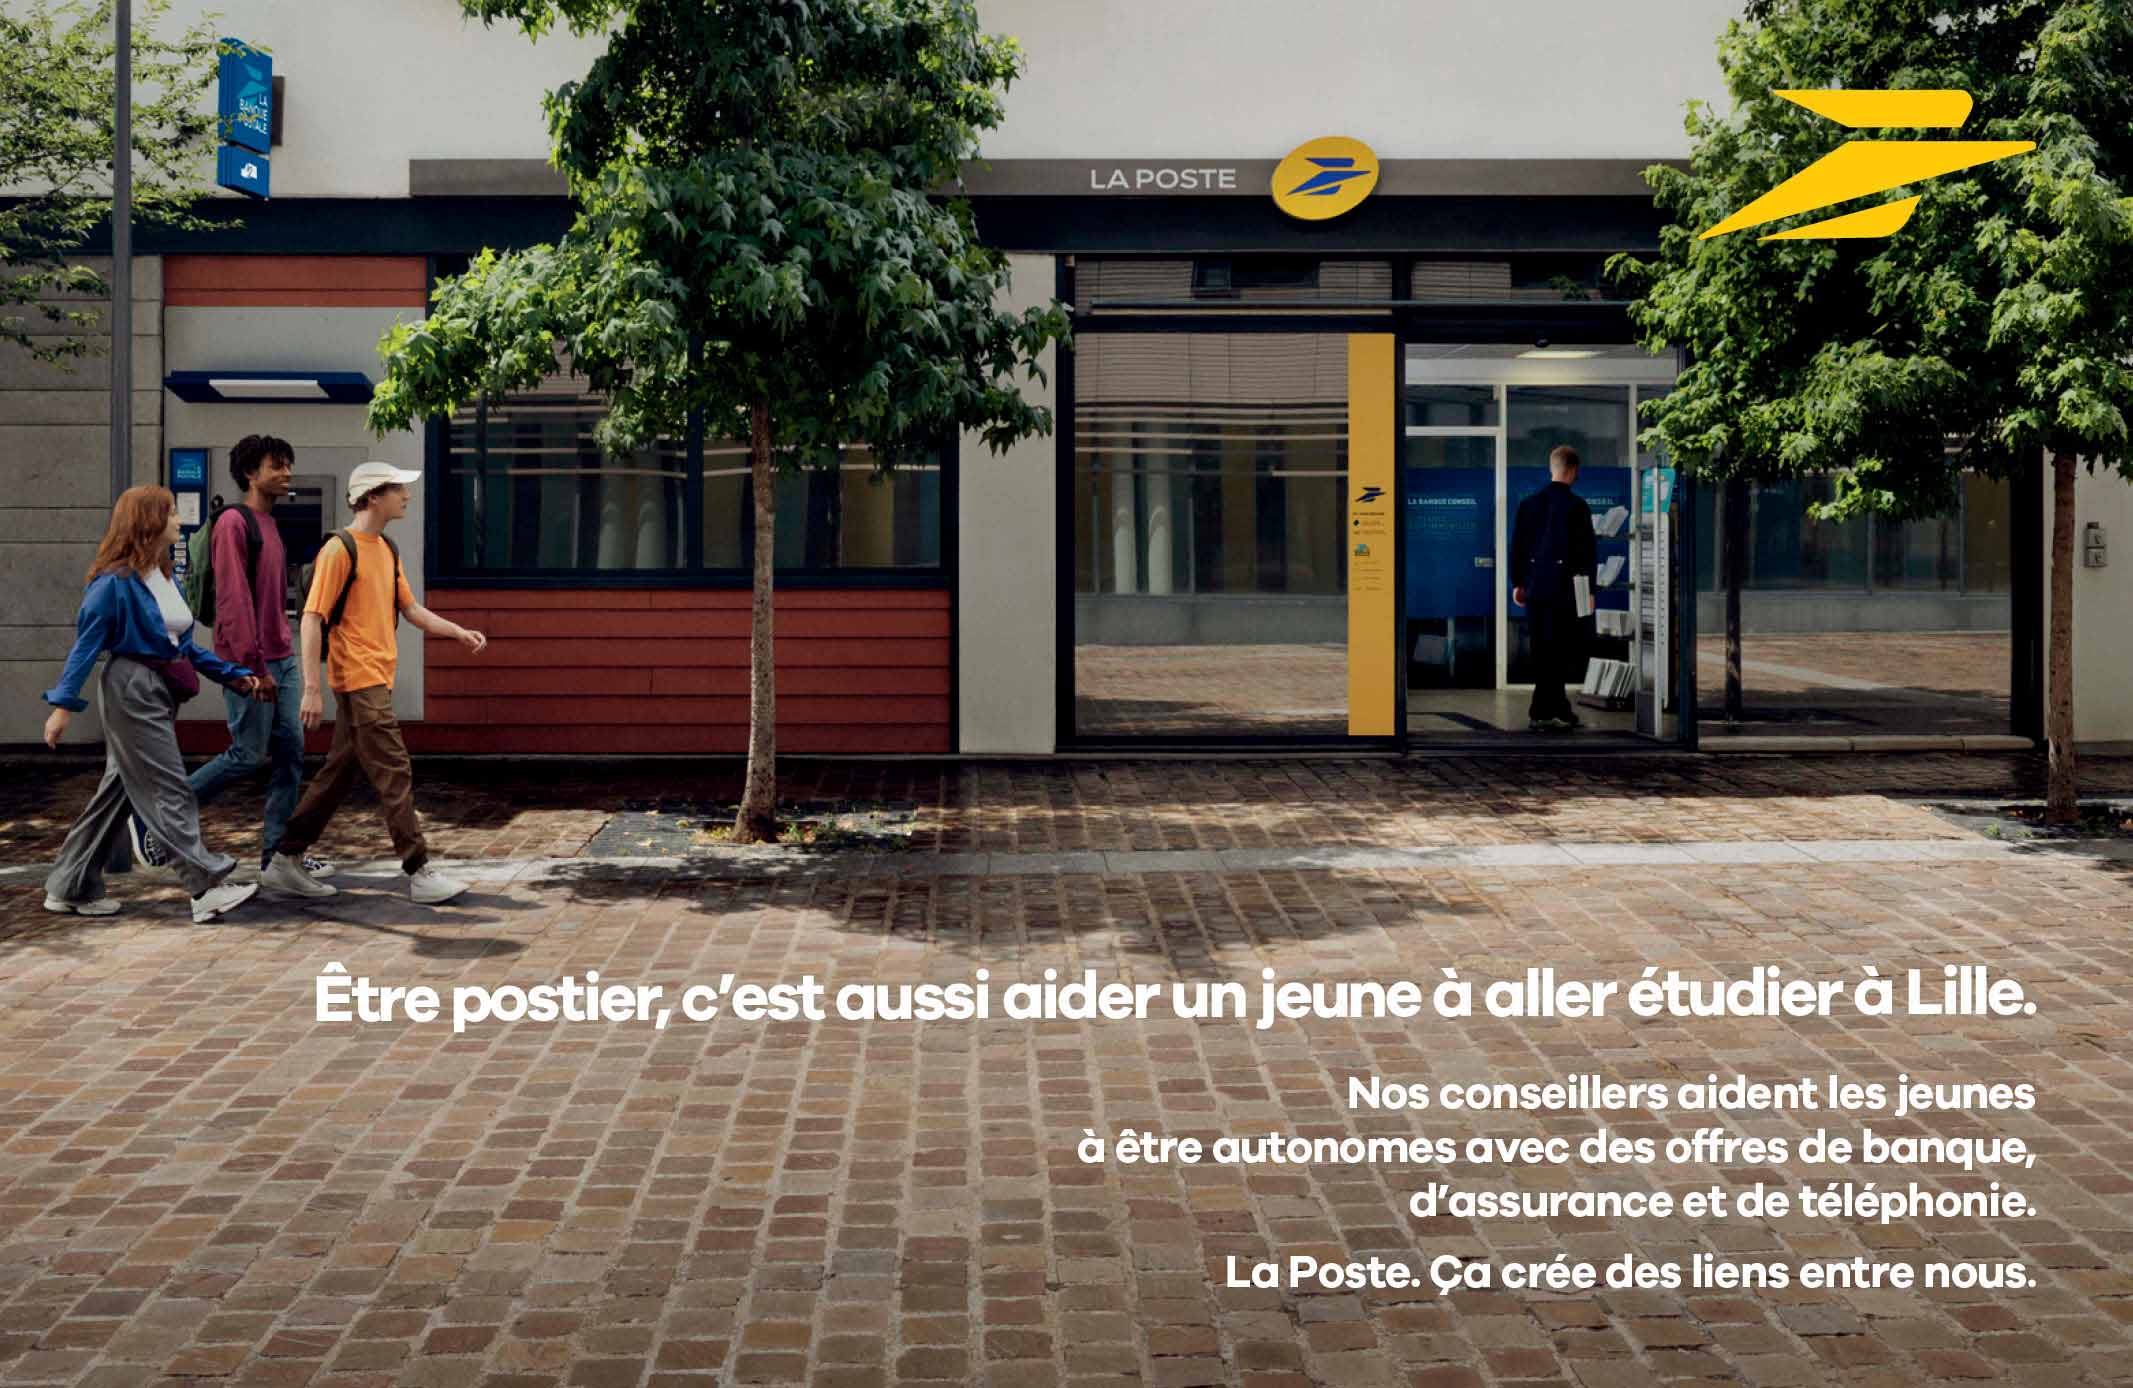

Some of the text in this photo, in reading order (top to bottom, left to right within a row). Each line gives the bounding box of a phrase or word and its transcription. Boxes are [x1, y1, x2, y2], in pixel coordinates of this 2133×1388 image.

[259, 94, 268, 106] LA
[1091, 168, 1237, 189] LA POSTE
